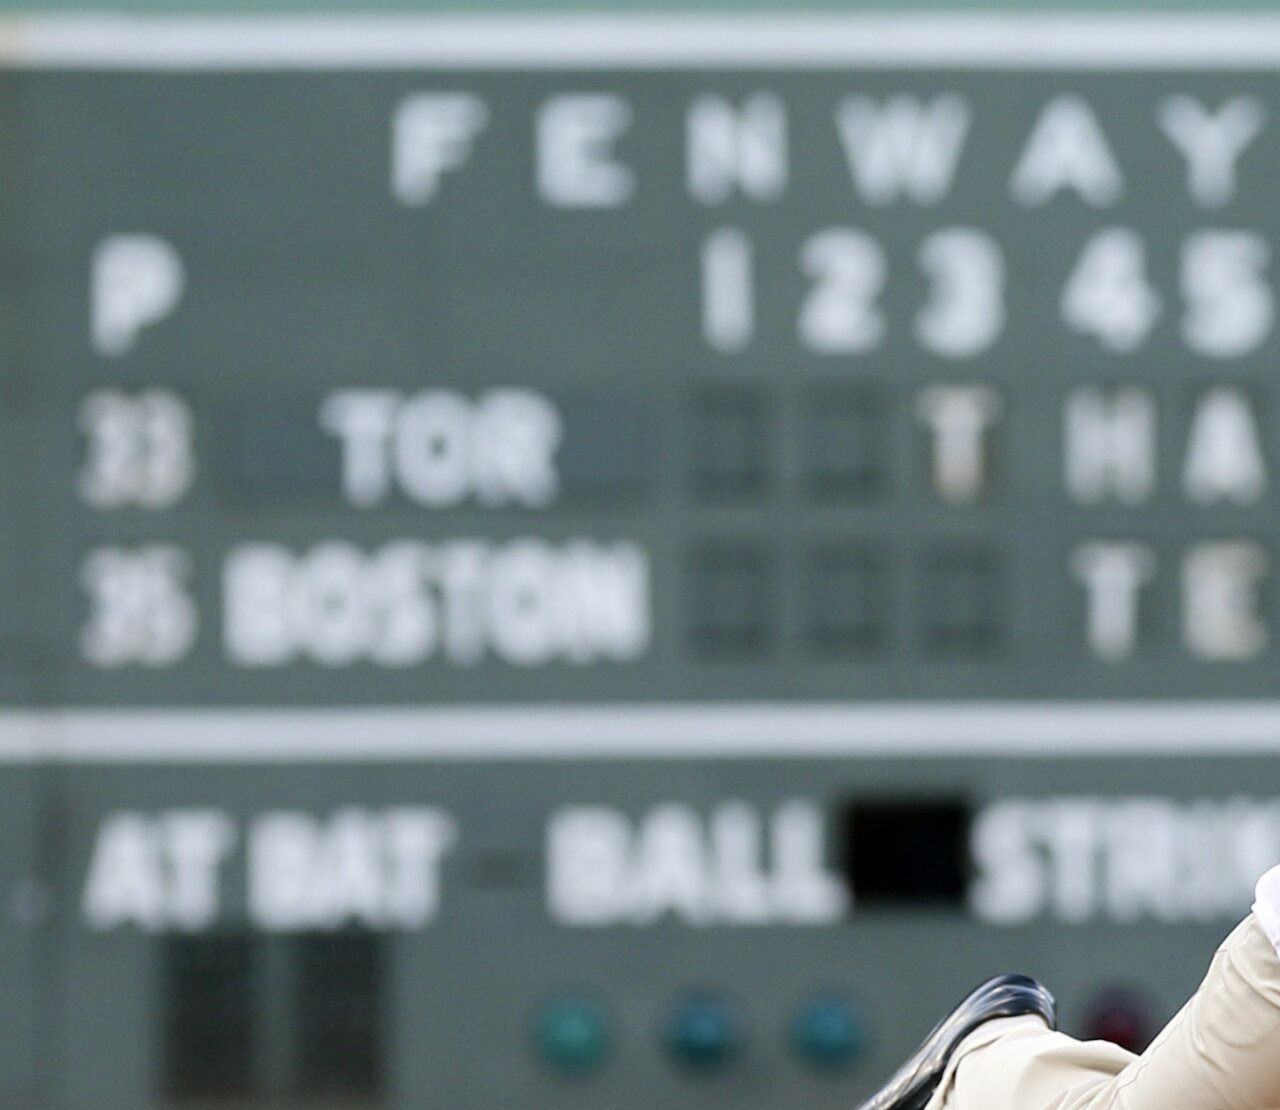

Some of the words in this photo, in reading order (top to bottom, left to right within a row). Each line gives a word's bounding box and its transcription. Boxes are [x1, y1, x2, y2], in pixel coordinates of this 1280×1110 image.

[390, 91, 1264, 207] FENWAY
[90, 234, 184, 356] P
[797, 226, 887, 355] 2
[915, 227, 1005, 358] 3
[1059, 227, 1161, 353] 4
[1179, 229, 1275, 358] 5
[321, 387, 562, 507] TOR
[221, 538, 650, 667] BOSTON
[83, 807, 236, 930] AT
[248, 806, 456, 930] BAT
[546, 801, 846, 926] BALL
